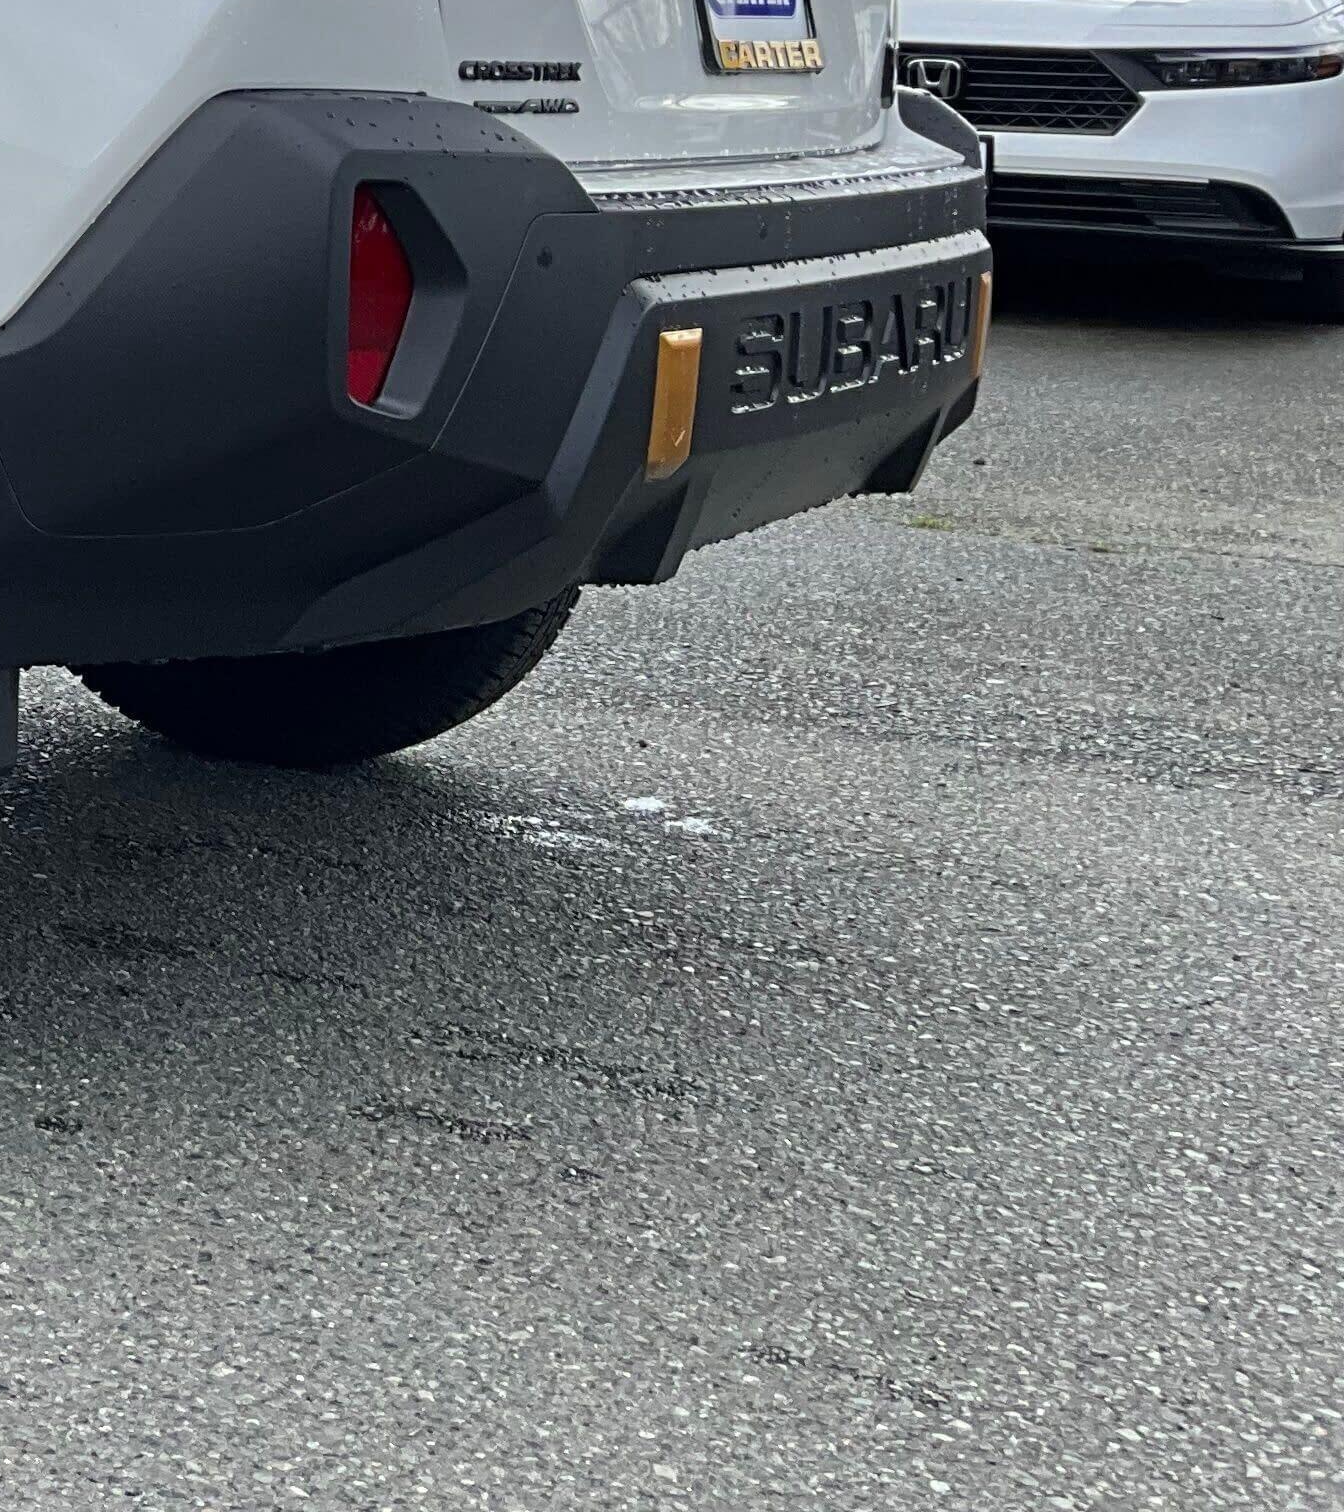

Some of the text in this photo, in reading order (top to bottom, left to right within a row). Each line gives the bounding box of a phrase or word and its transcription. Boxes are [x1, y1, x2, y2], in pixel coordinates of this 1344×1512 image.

[717, 39, 824, 70] CARTER
[457, 60, 582, 81] CROSSTREK
[519, 98, 580, 114] AWD
[730, 276, 973, 415] SUBARU
